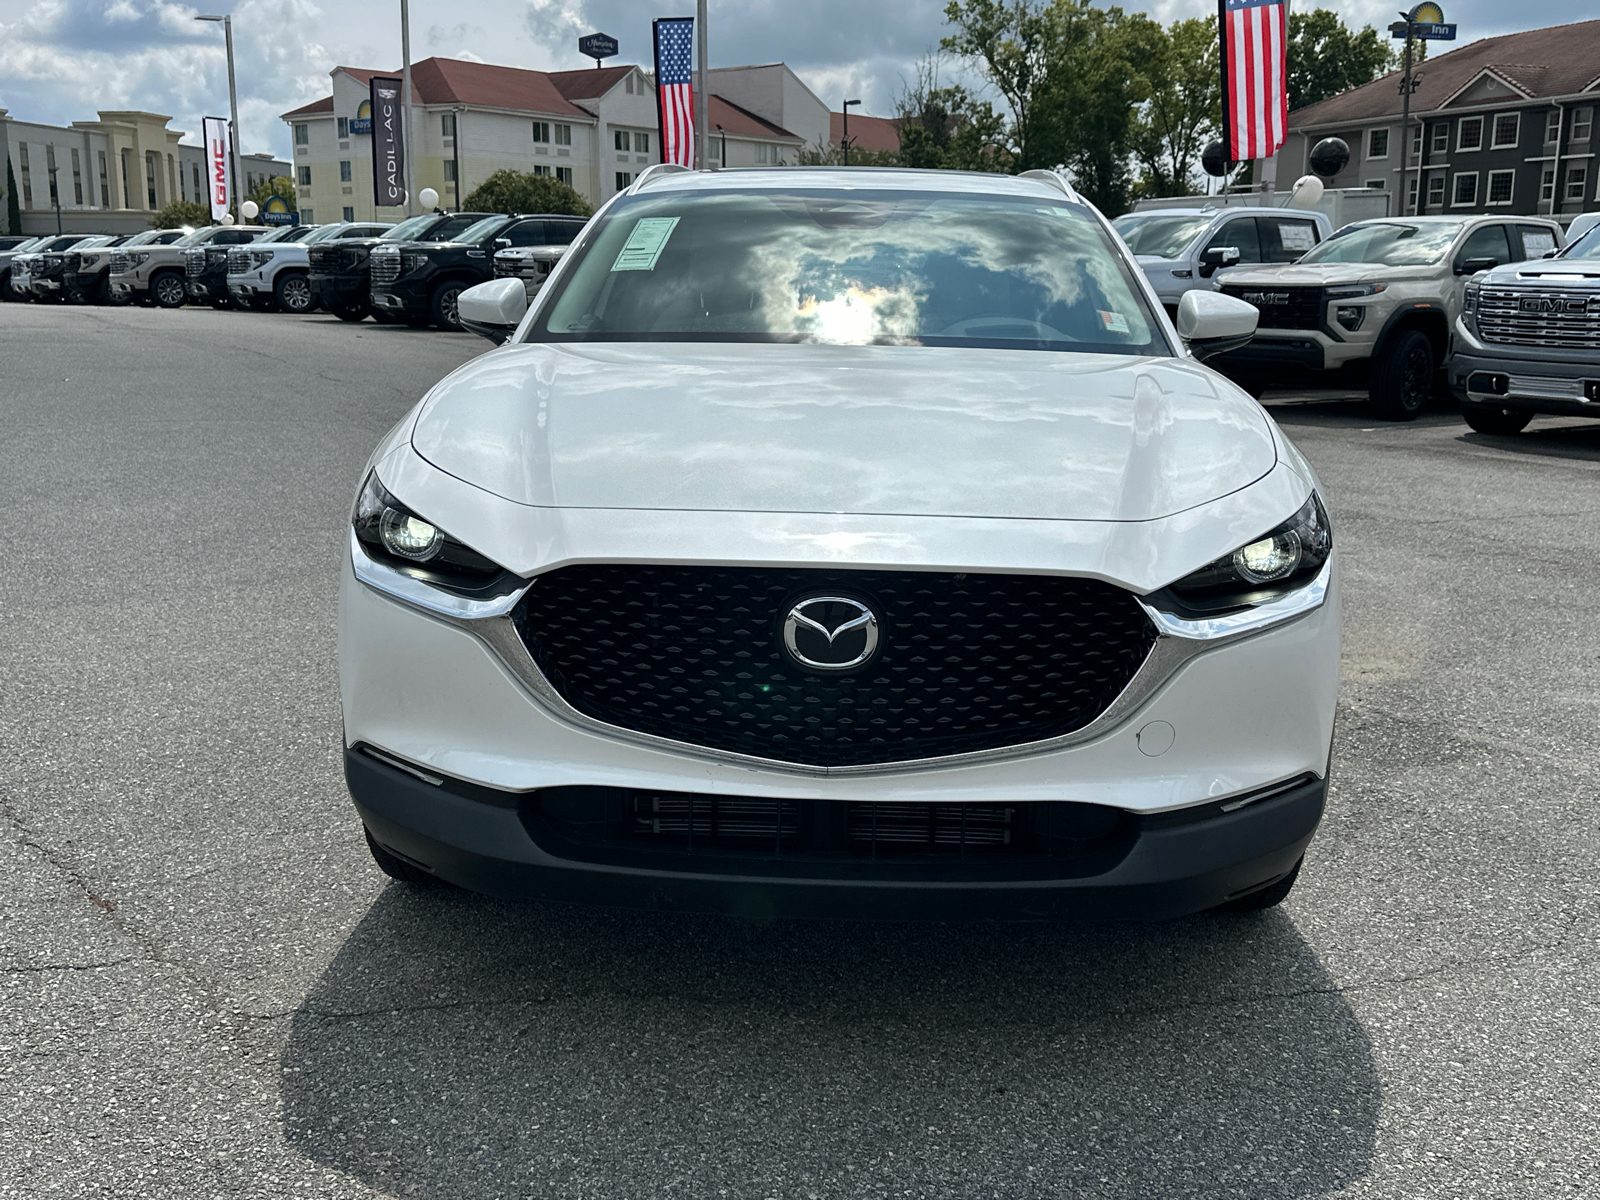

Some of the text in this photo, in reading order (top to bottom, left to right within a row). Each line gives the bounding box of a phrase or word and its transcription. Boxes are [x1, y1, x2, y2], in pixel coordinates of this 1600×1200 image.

[1431, 25, 1449, 34] Inn
[354, 120, 371, 129] Days
[384, 105, 398, 198] CADILLAC
[213, 139, 226, 205] GMC
[264, 212, 280, 221] Days
[1242, 292, 1289, 305] GMC
[1522, 298, 1585, 312] GMC
